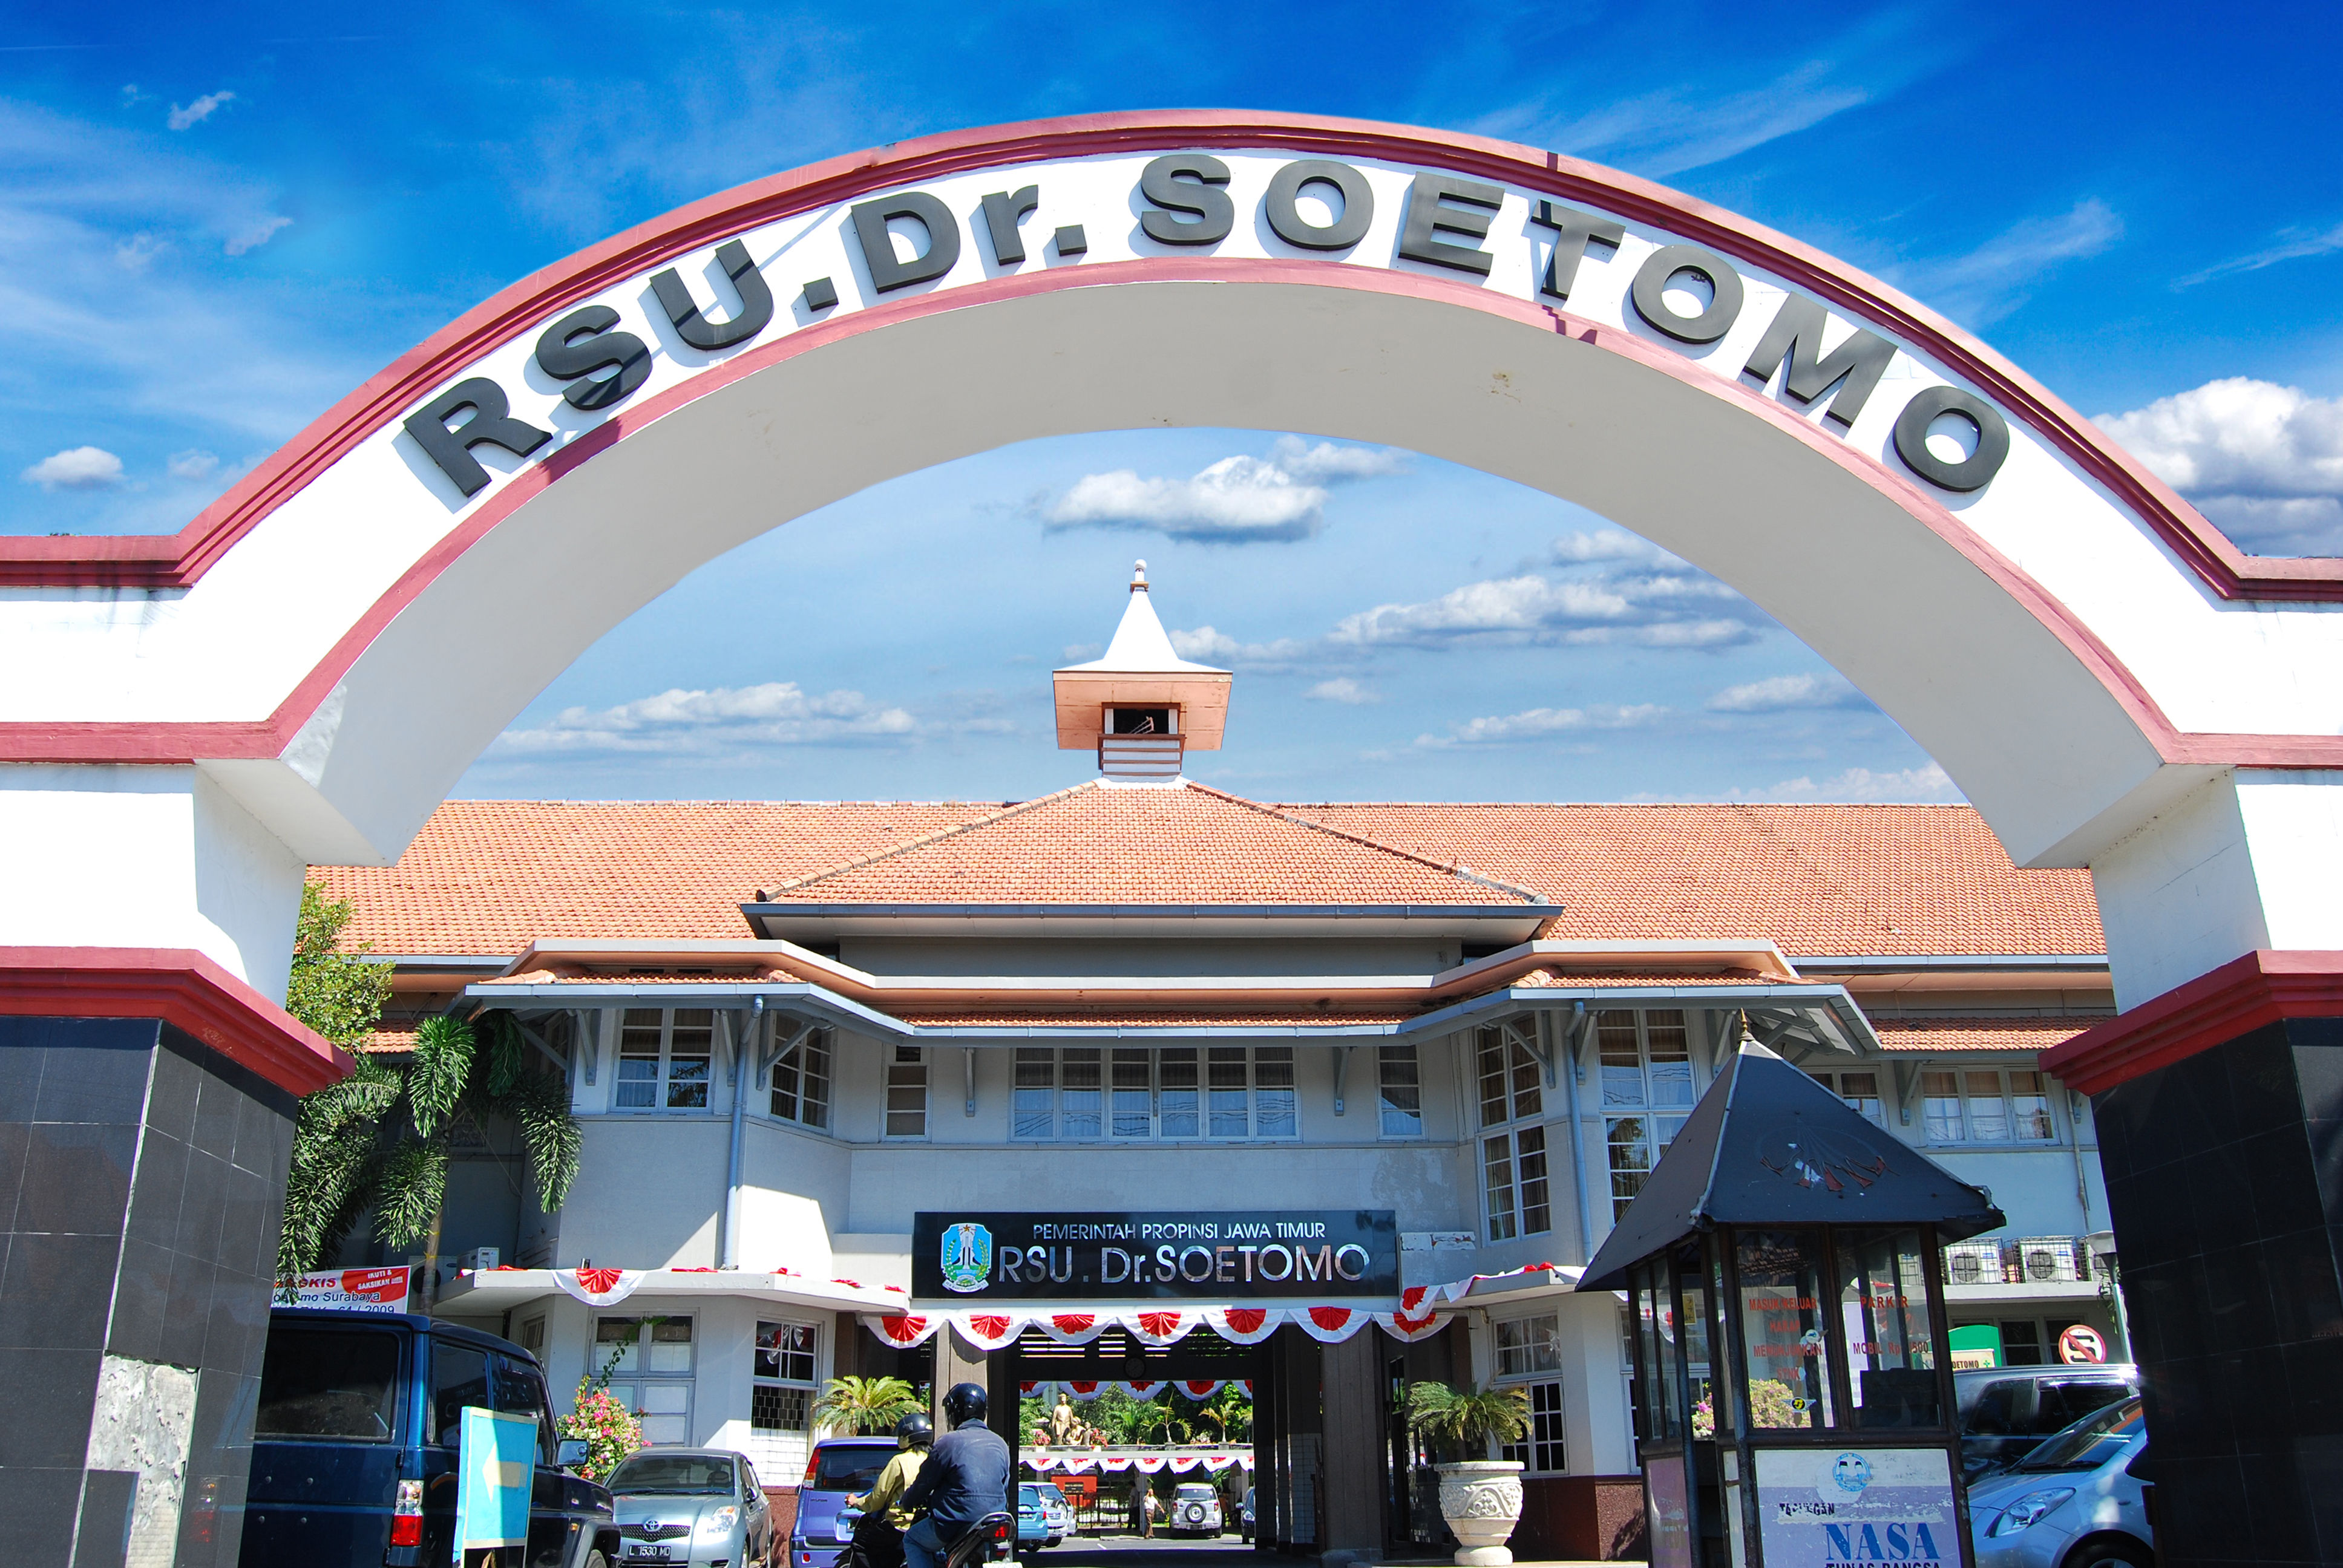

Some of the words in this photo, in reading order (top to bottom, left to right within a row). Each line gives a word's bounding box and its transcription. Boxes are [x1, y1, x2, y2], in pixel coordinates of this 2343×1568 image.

[1140, 154, 2010, 492] SOETOMO
[1033, 1223, 1136, 1240] PEMERINTAH
[1142, 1223, 1218, 1240] PROPINSI
[1224, 1223, 1271, 1240] JAWA
[1276, 1223, 1326, 1238] TIMUR
[367, 1270, 386, 1279] IKUTI
[358, 1279, 390, 1290] SAKSIKAN
[323, 1292, 380, 1303] Surabaya
[1860, 1296, 1909, 1308] PARKIR
[1769, 1320, 1801, 1333] HARAP
[1853, 1342, 1883, 1354] MOBIL
[1888, 1342, 1901, 1355] Rp
[1823, 1523, 1940, 1561] NASA
[629, 1545, 635, 1556] L
[638, 1546, 657, 1556] 1530
